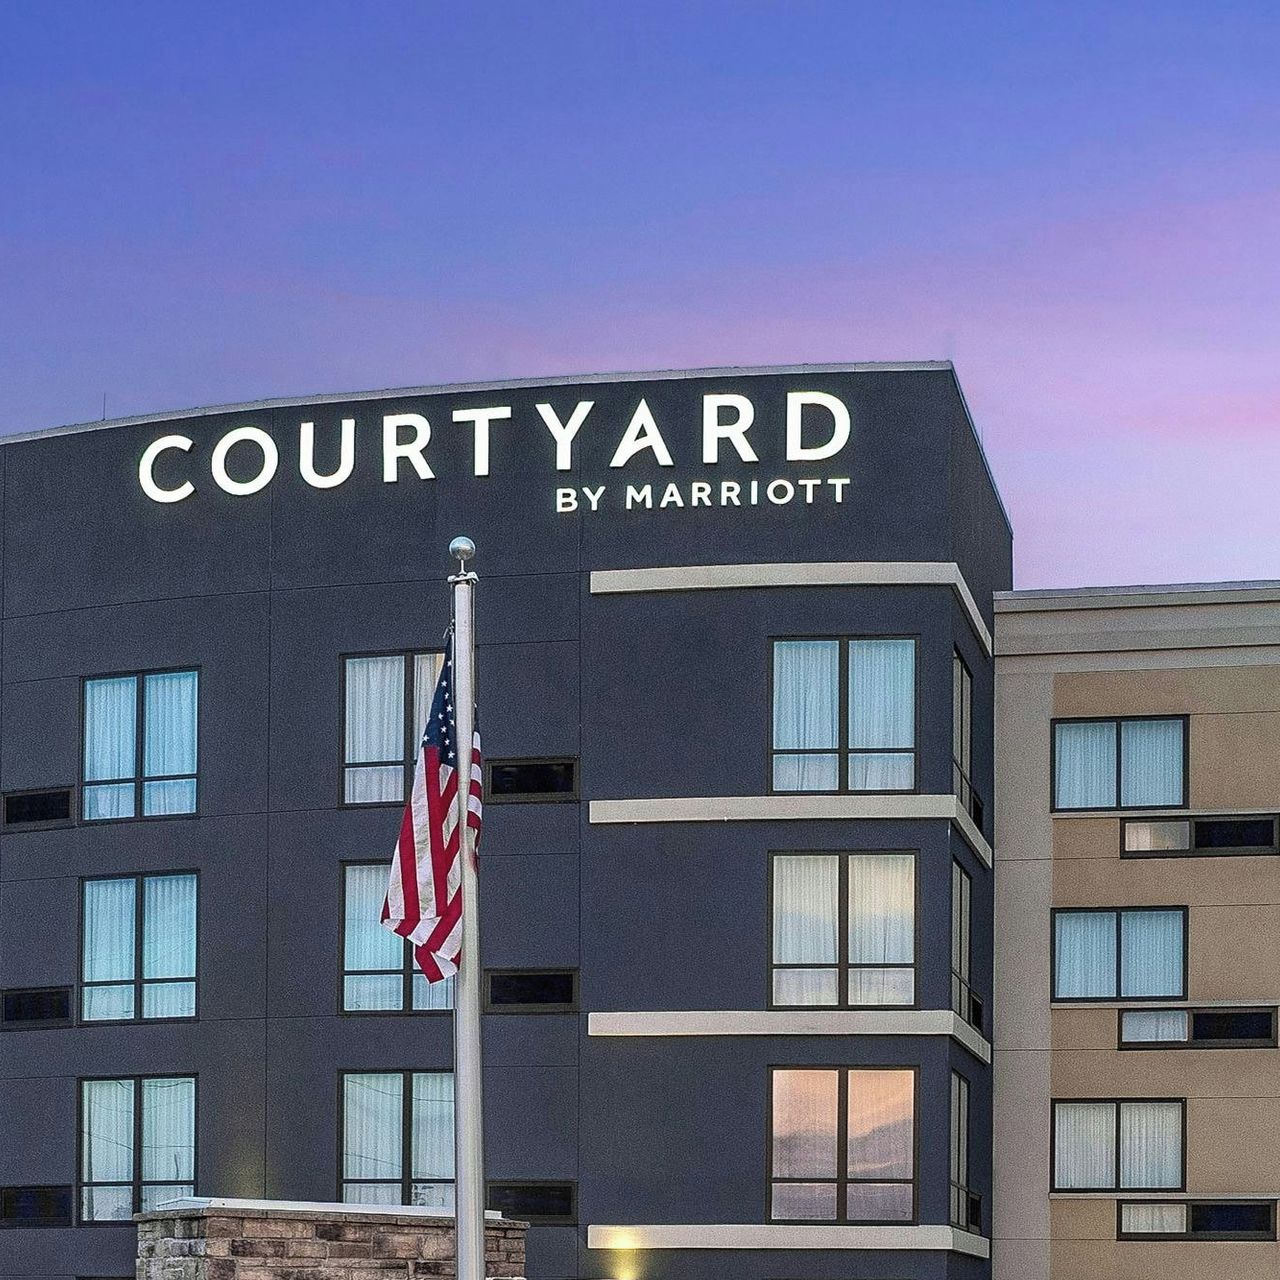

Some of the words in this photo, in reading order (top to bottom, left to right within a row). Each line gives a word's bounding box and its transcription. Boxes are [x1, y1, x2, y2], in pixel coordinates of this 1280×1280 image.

[137, 390, 852, 504] COURTYARD
[556, 485, 607, 513] BY
[624, 477, 852, 511] MARRIOTT
